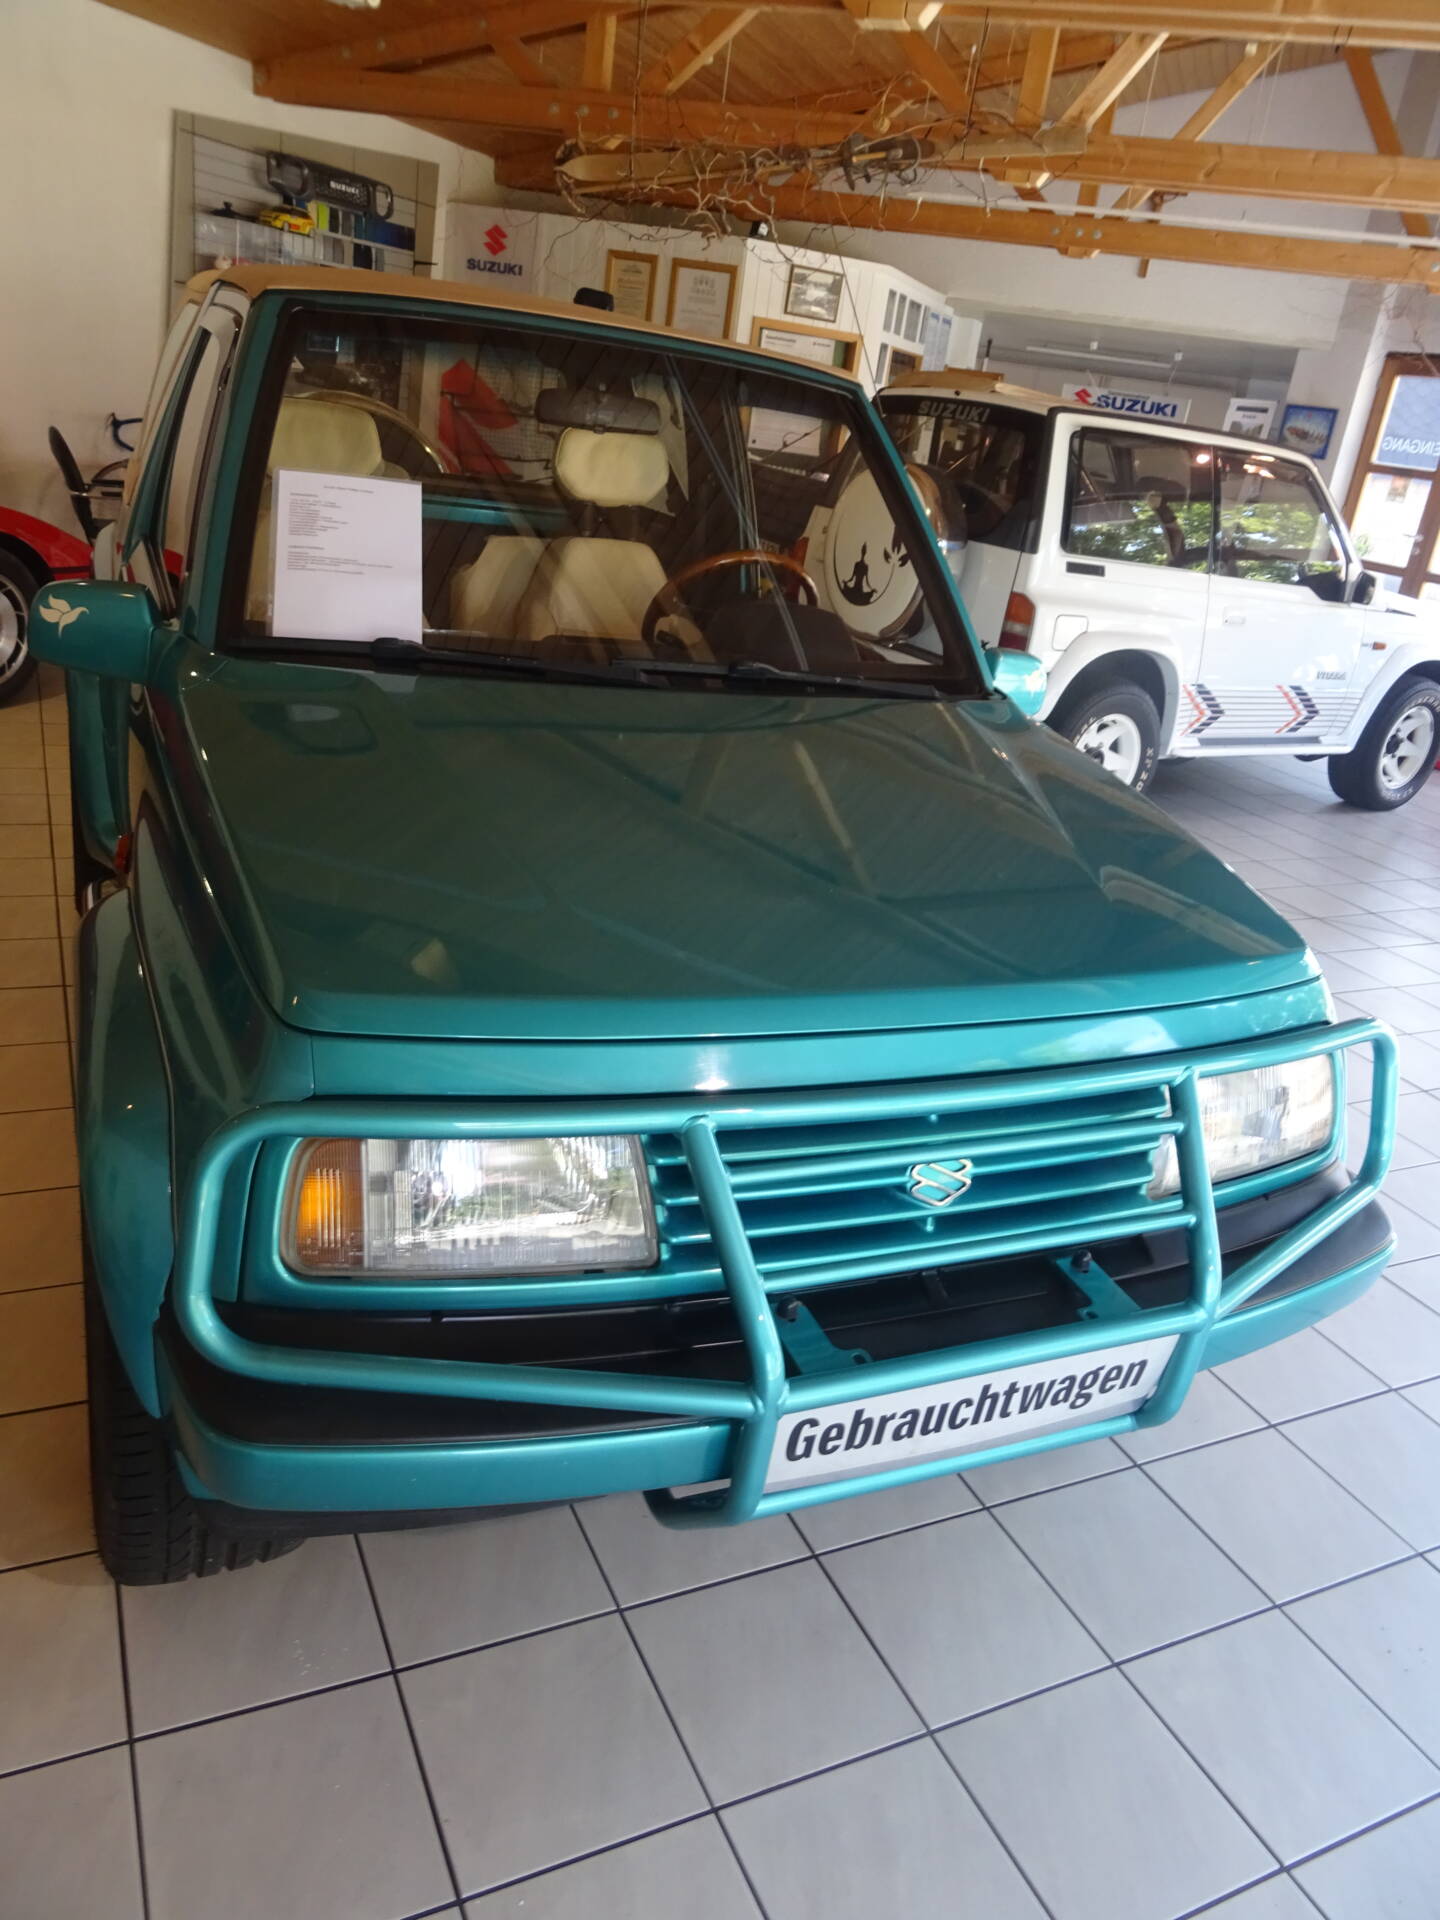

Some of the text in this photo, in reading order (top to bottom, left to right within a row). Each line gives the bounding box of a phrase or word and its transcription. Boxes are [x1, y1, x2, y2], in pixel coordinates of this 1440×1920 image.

[467, 258, 523, 276] SUZUKI
[918, 401, 991, 422] SUZUKI
[1095, 394, 1178, 418] SUZUKI
[785, 1358, 1148, 1462] Gebrauchtwagen
